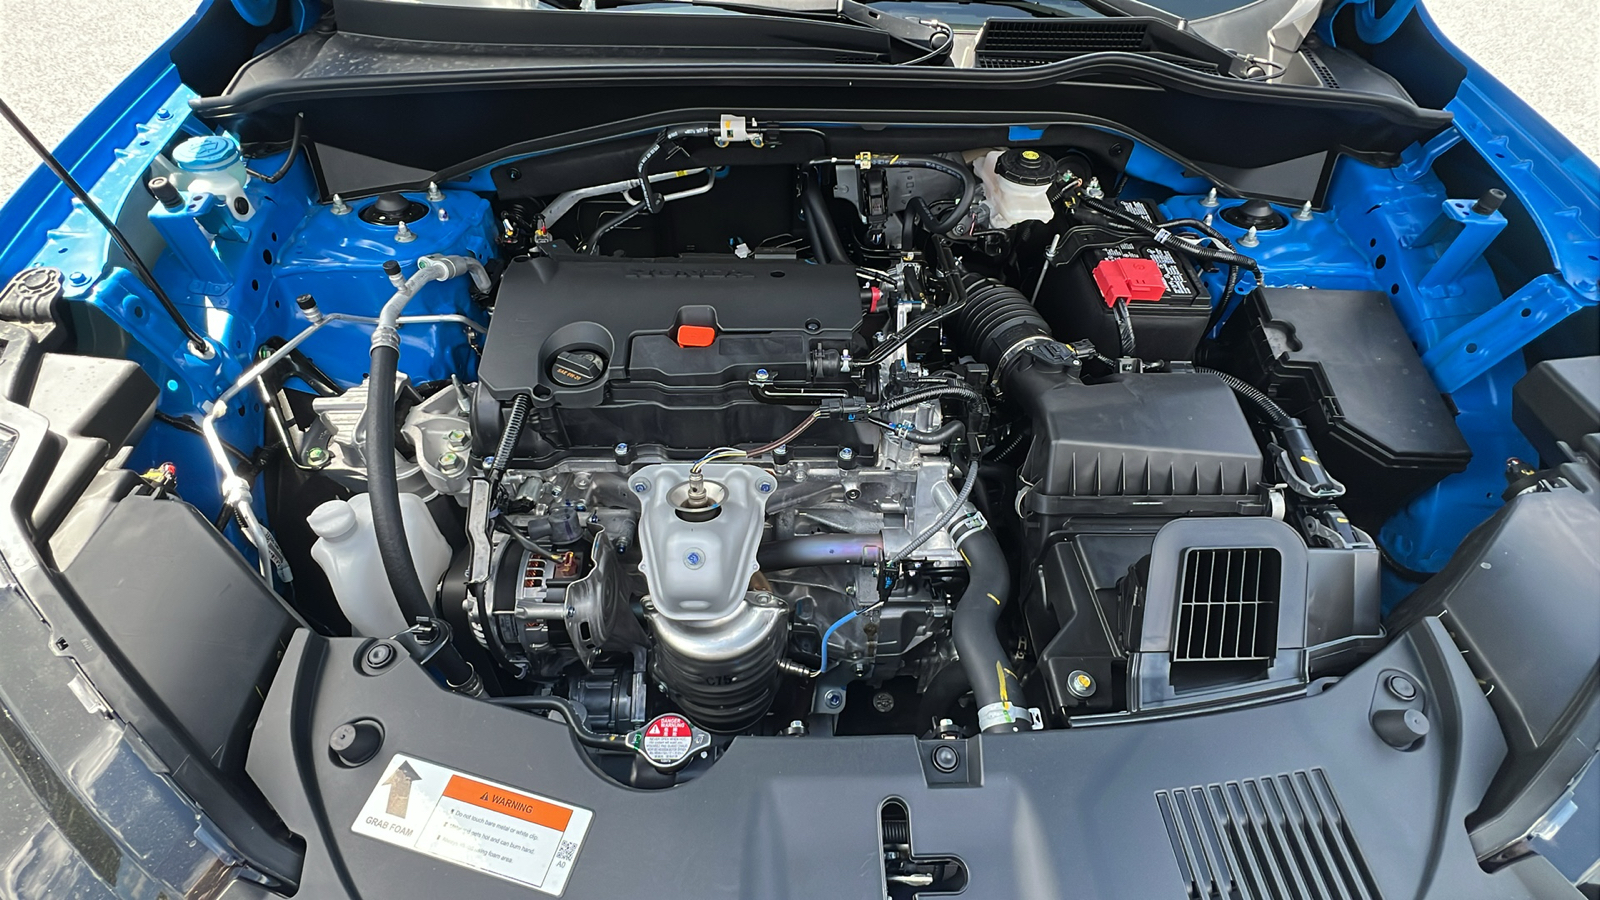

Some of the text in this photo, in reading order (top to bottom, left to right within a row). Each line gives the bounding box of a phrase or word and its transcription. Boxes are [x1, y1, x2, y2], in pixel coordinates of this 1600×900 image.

[492, 794, 533, 814] WARNING
[365, 816, 414, 837] GRAB FOAM
[471, 815, 484, 824] touch
[496, 823, 510, 832] metal
[516, 829, 529, 838] white
[482, 833, 491, 841] hot
[490, 836, 501, 844] and
